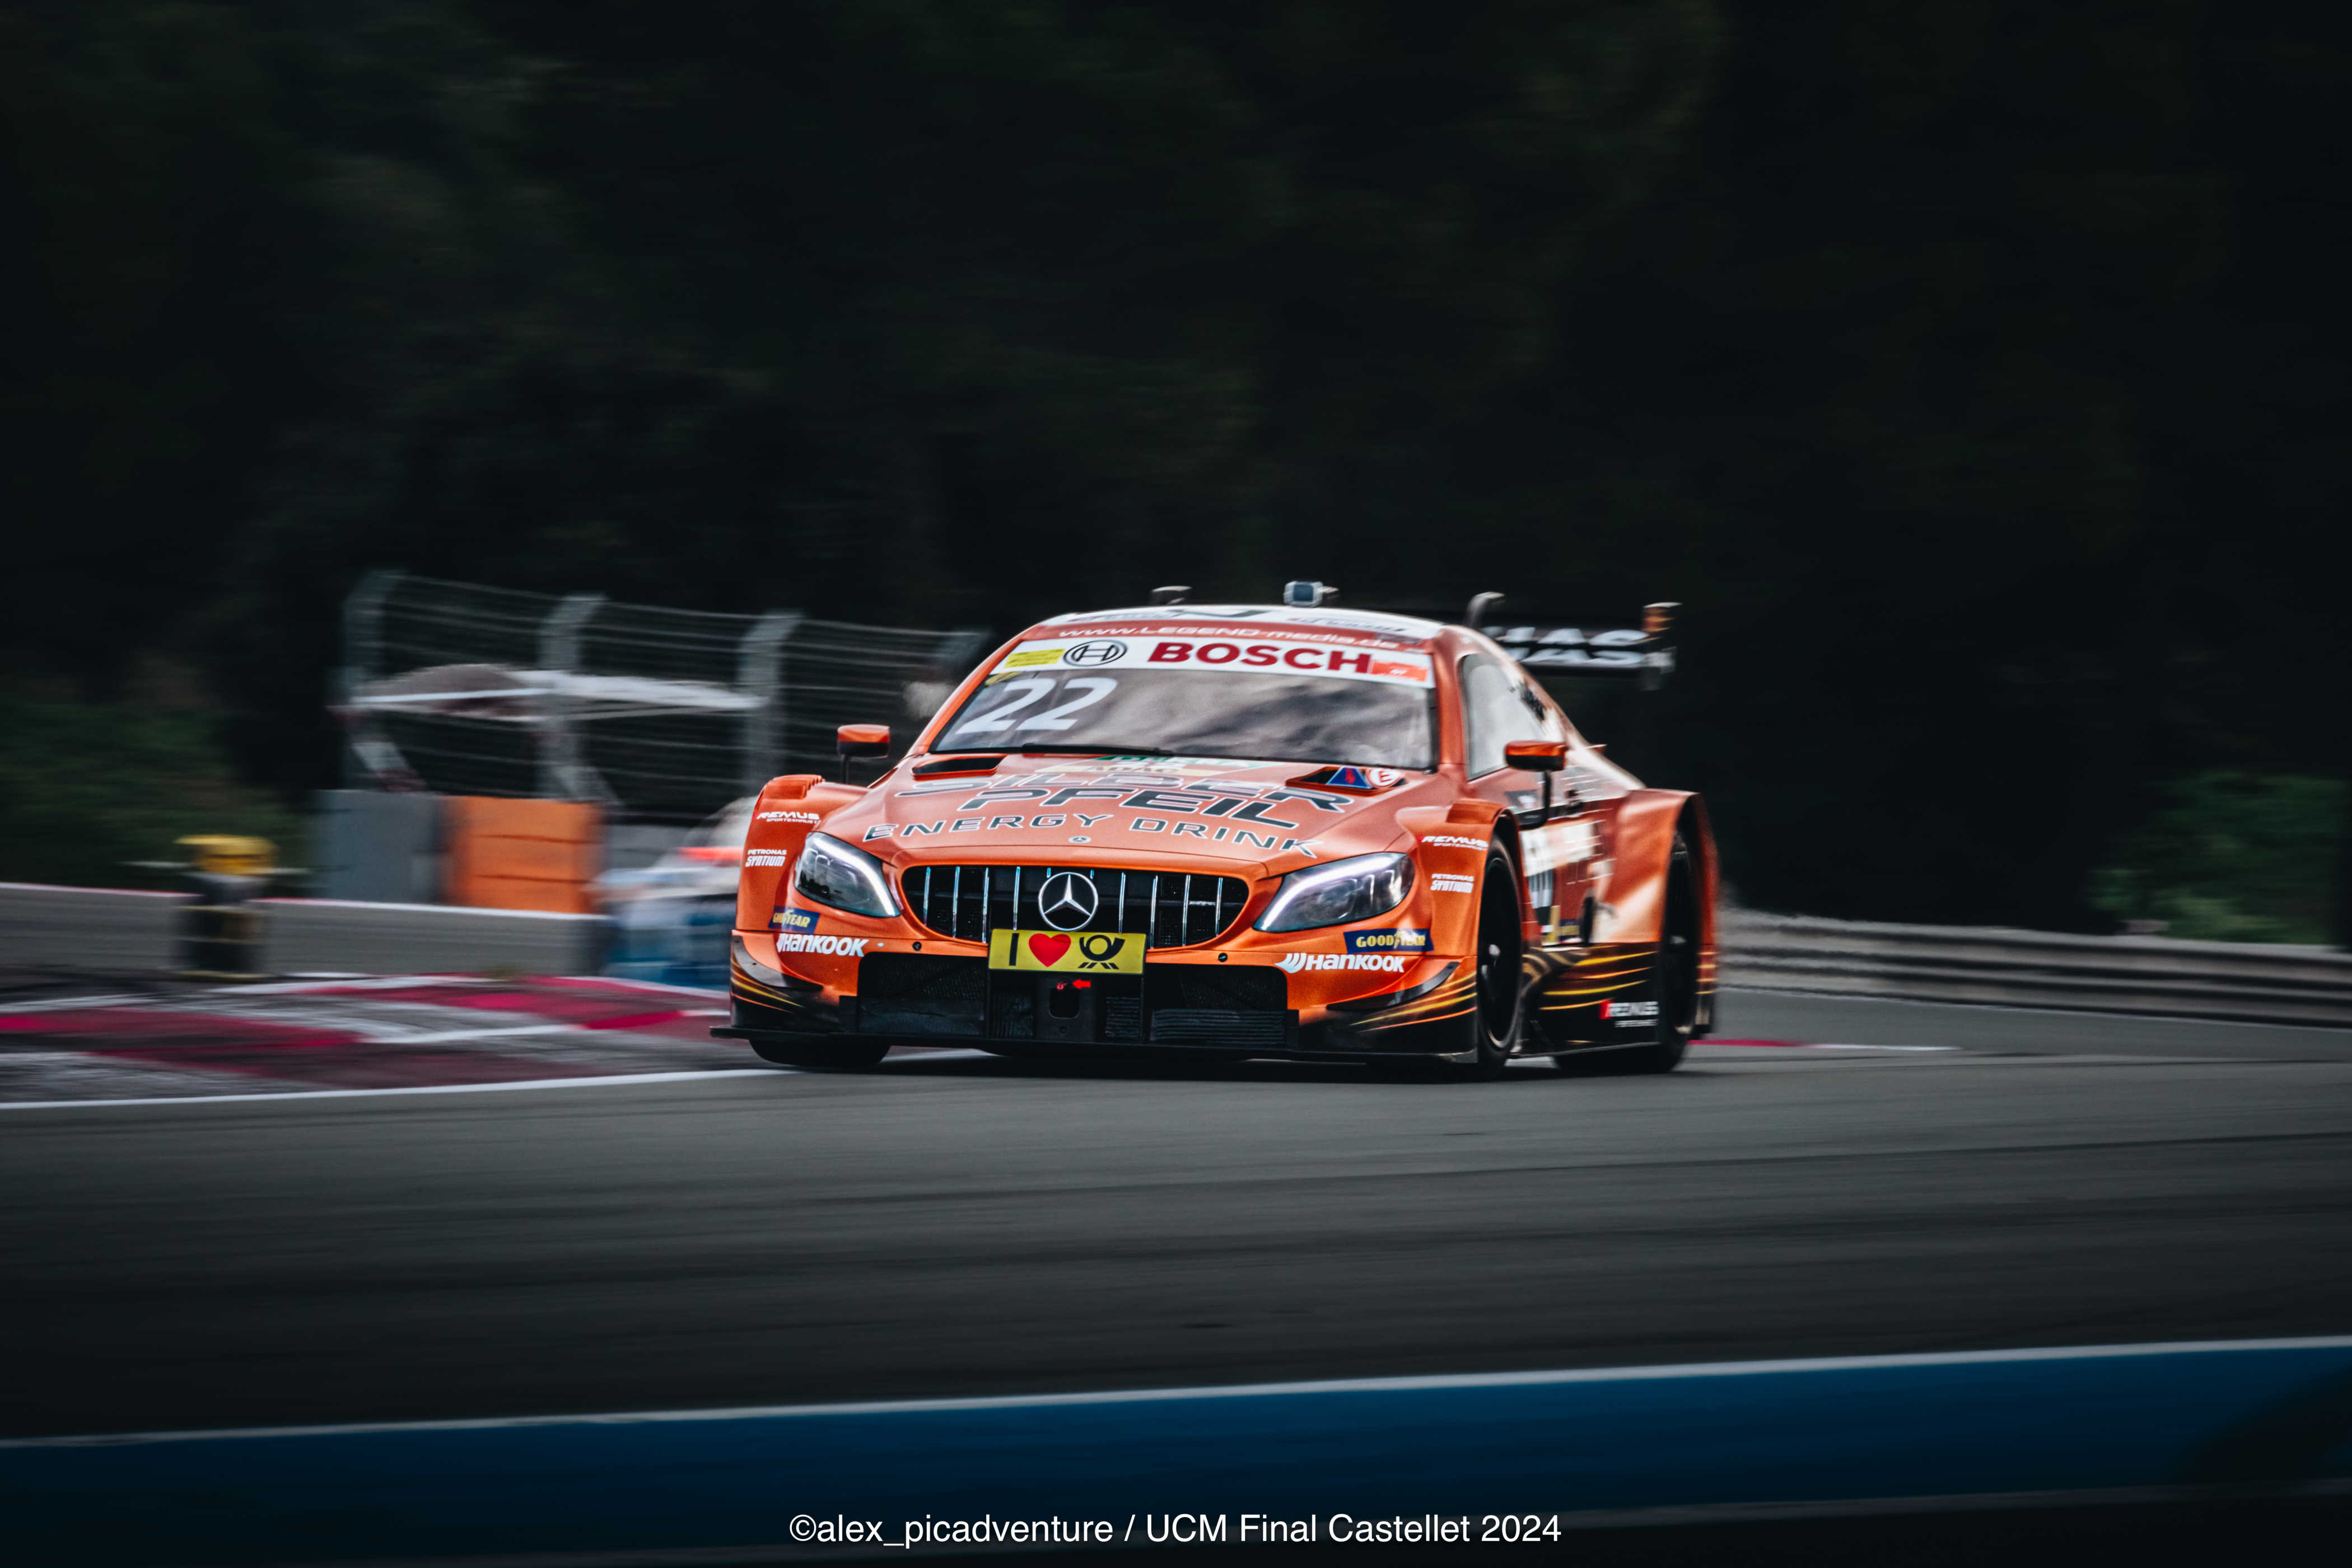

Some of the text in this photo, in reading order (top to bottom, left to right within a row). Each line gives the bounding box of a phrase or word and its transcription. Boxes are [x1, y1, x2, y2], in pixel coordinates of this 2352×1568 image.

[1147, 642, 1372, 674] BOSCH
[955, 677, 1118, 735] 22
[894, 773, 1355, 813] SILBER
[956, 787, 1300, 830] PFEIL
[756, 811, 819, 820] REMUS
[862, 814, 1323, 858] ENERGY DRINK
[1421, 836, 1488, 848] REMUS
[745, 855, 786, 867] SYNTIUM
[1009, 933, 1020, 967] I
